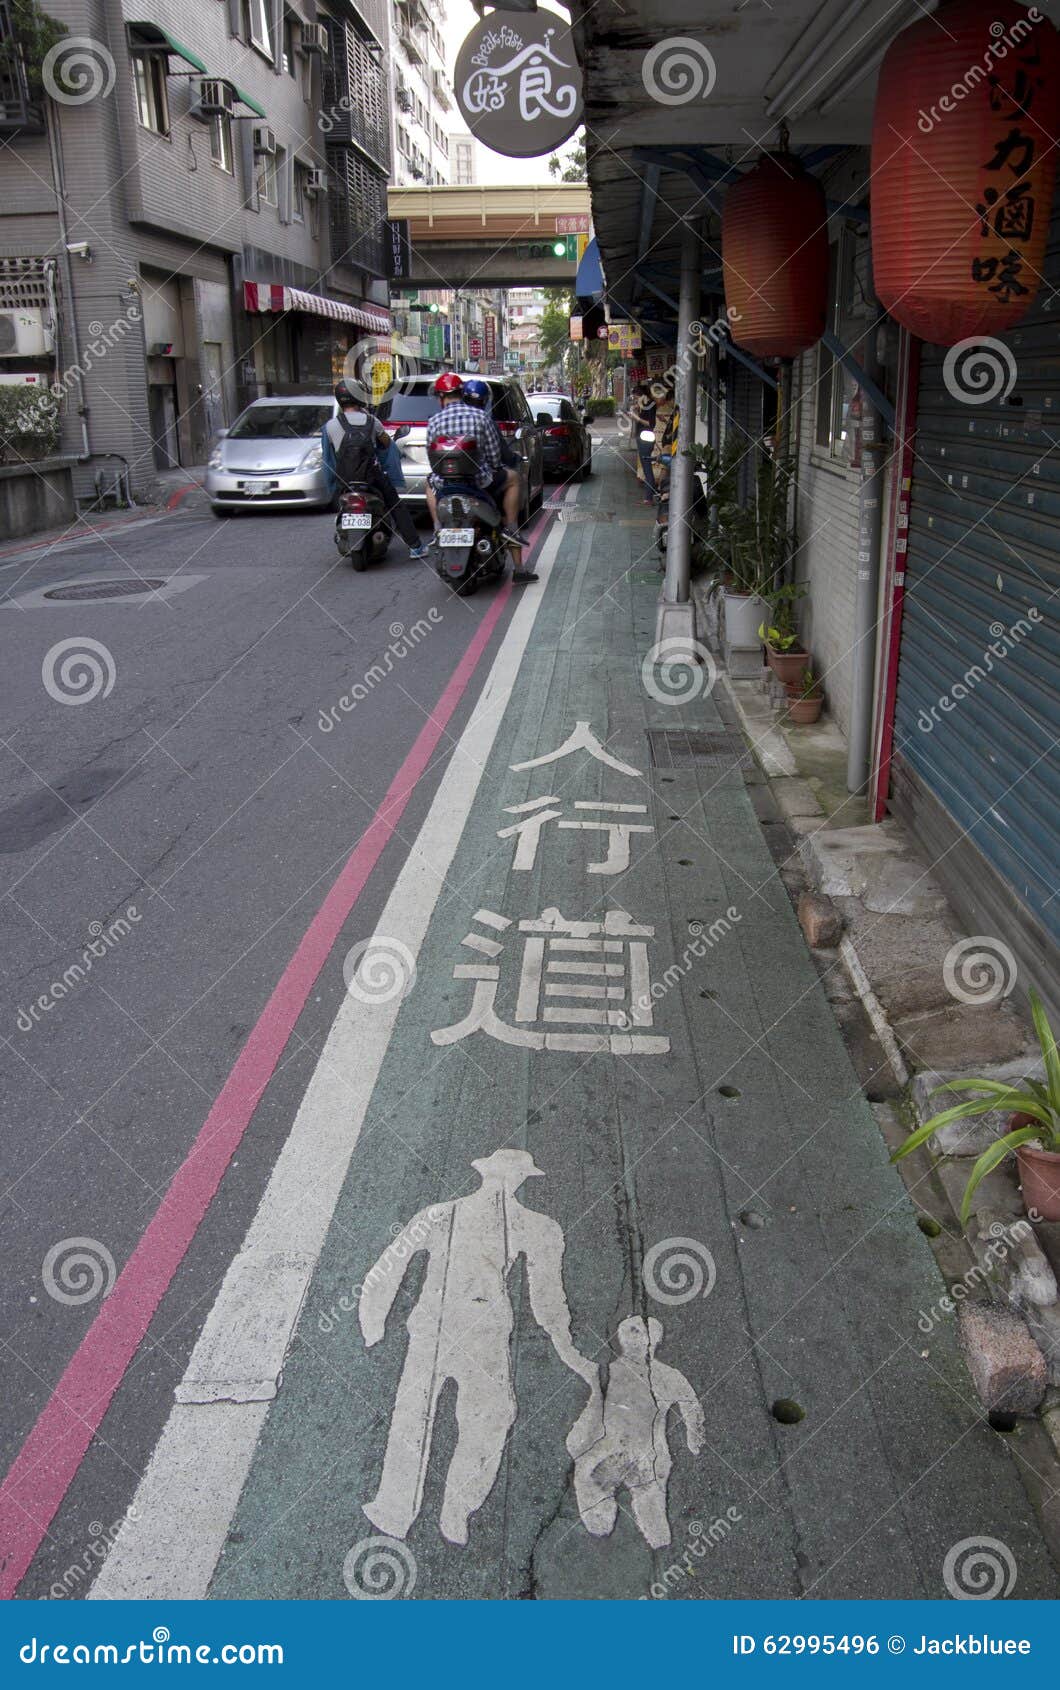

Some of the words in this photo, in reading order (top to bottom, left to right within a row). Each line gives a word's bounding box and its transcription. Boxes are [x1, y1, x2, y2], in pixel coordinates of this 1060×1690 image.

[471, 25, 525, 67] Breakfast
[430, 721, 671, 1055] 人行道
